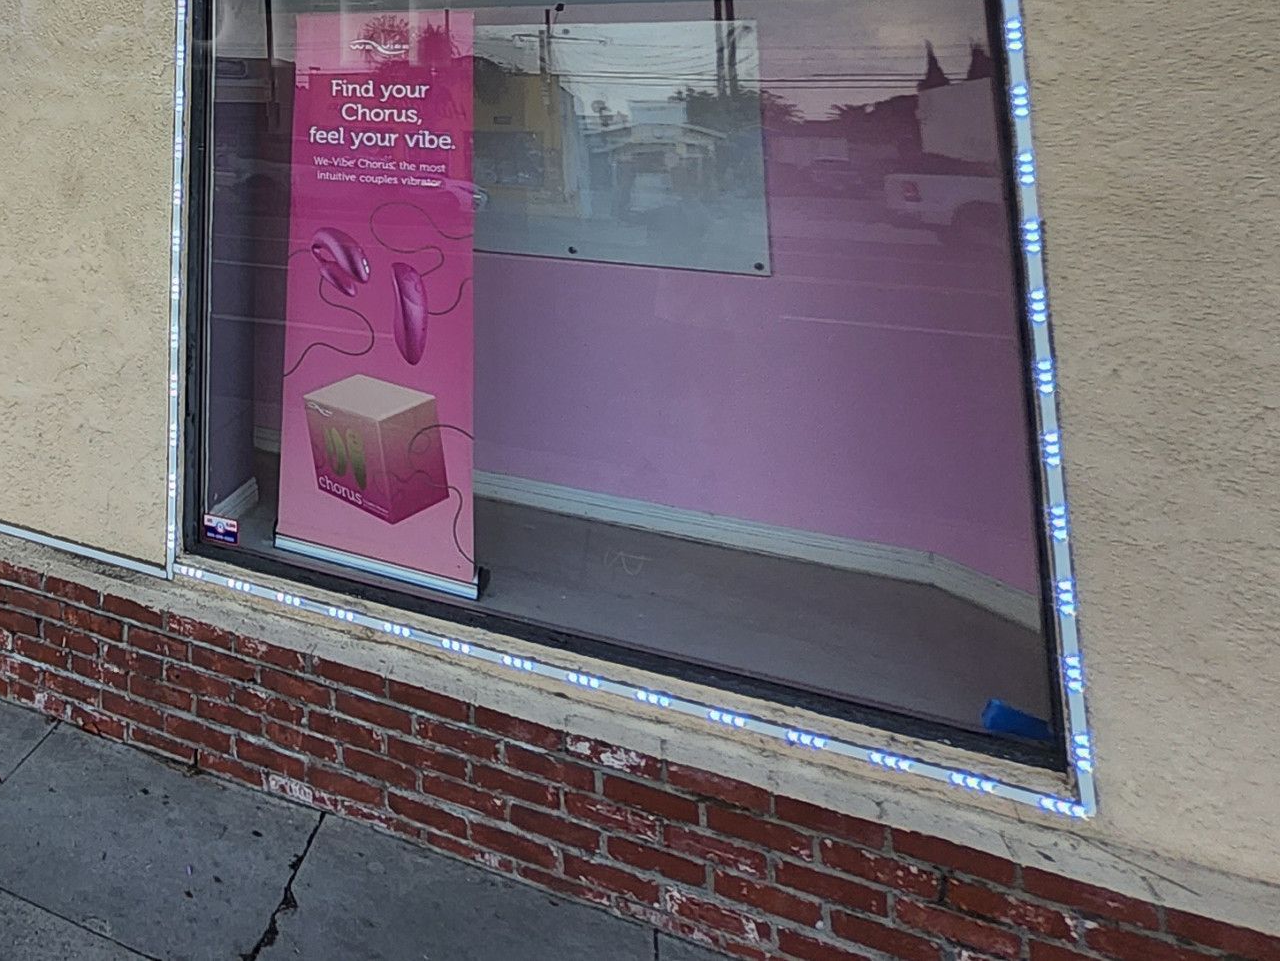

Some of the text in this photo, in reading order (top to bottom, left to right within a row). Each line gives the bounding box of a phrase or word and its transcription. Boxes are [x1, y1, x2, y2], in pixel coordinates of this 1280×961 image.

[331, 80, 429, 102] Find your
[341, 104, 423, 125] Chorus,
[309, 127, 456, 150] feel your vibe.
[399, 160, 417, 171] the
[419, 163, 446, 173] most
[317, 170, 357, 182] intuitive
[359, 174, 399, 185] couples
[318, 475, 363, 505] chorus
